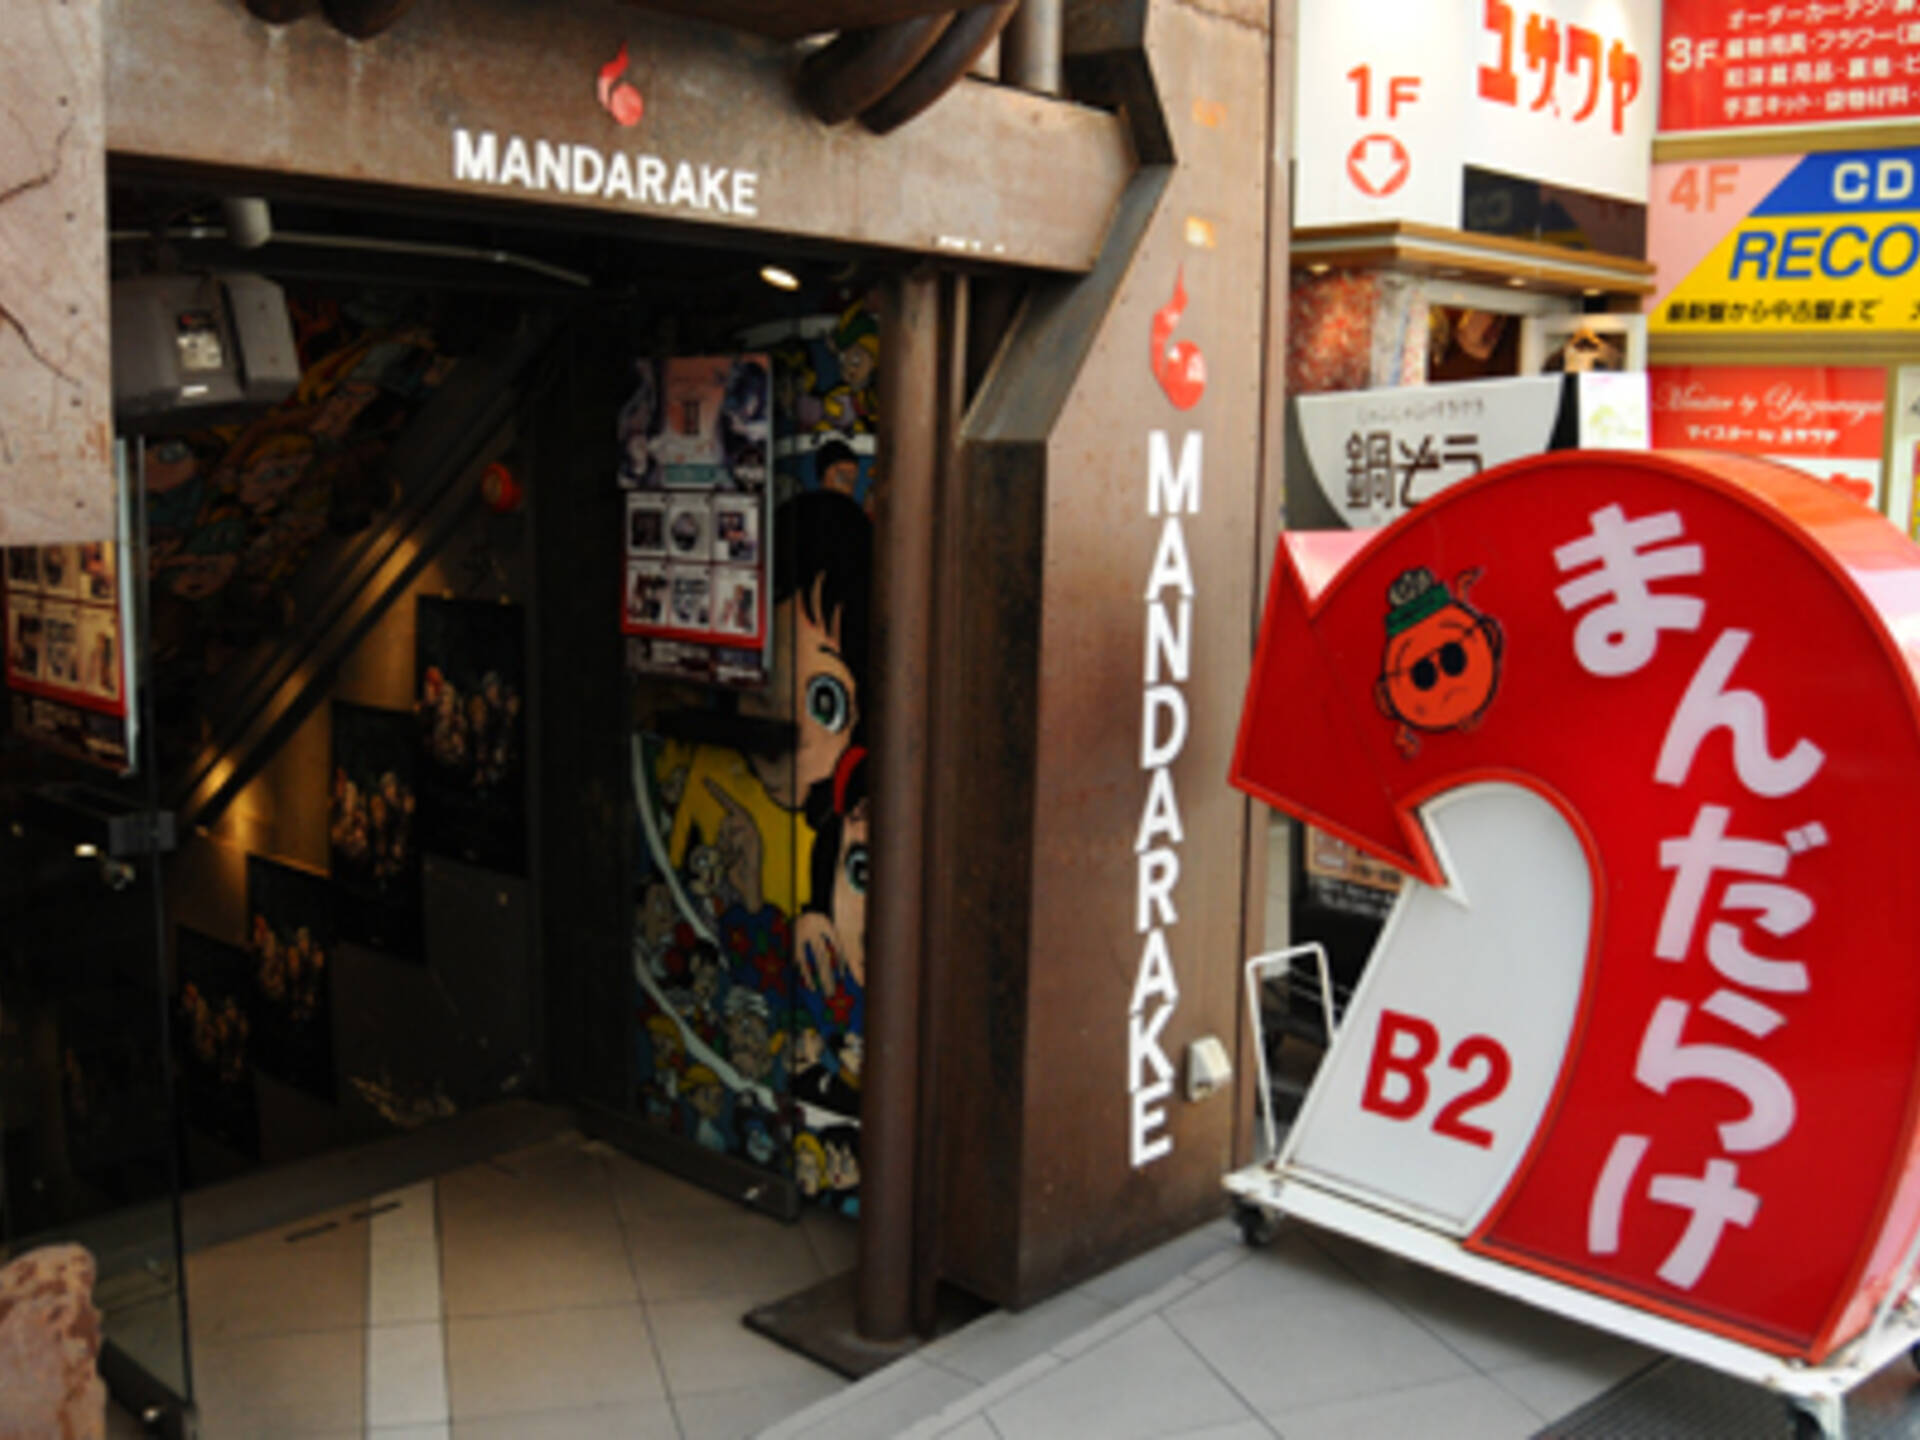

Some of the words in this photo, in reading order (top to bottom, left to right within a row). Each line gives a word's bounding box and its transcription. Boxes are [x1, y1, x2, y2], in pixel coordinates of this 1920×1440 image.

[1667, 36, 1720, 73] 3F
[1347, 63, 1422, 119] 1F
[453, 129, 758, 216] MANDARAKE
[1668, 163, 1741, 213] 4F
[1833, 158, 1915, 203] CD
[1128, 431, 1202, 1168] MANDARAKE
[1552, 503, 1829, 1290] まんだらけ
[1360, 1009, 1513, 1151] B2
